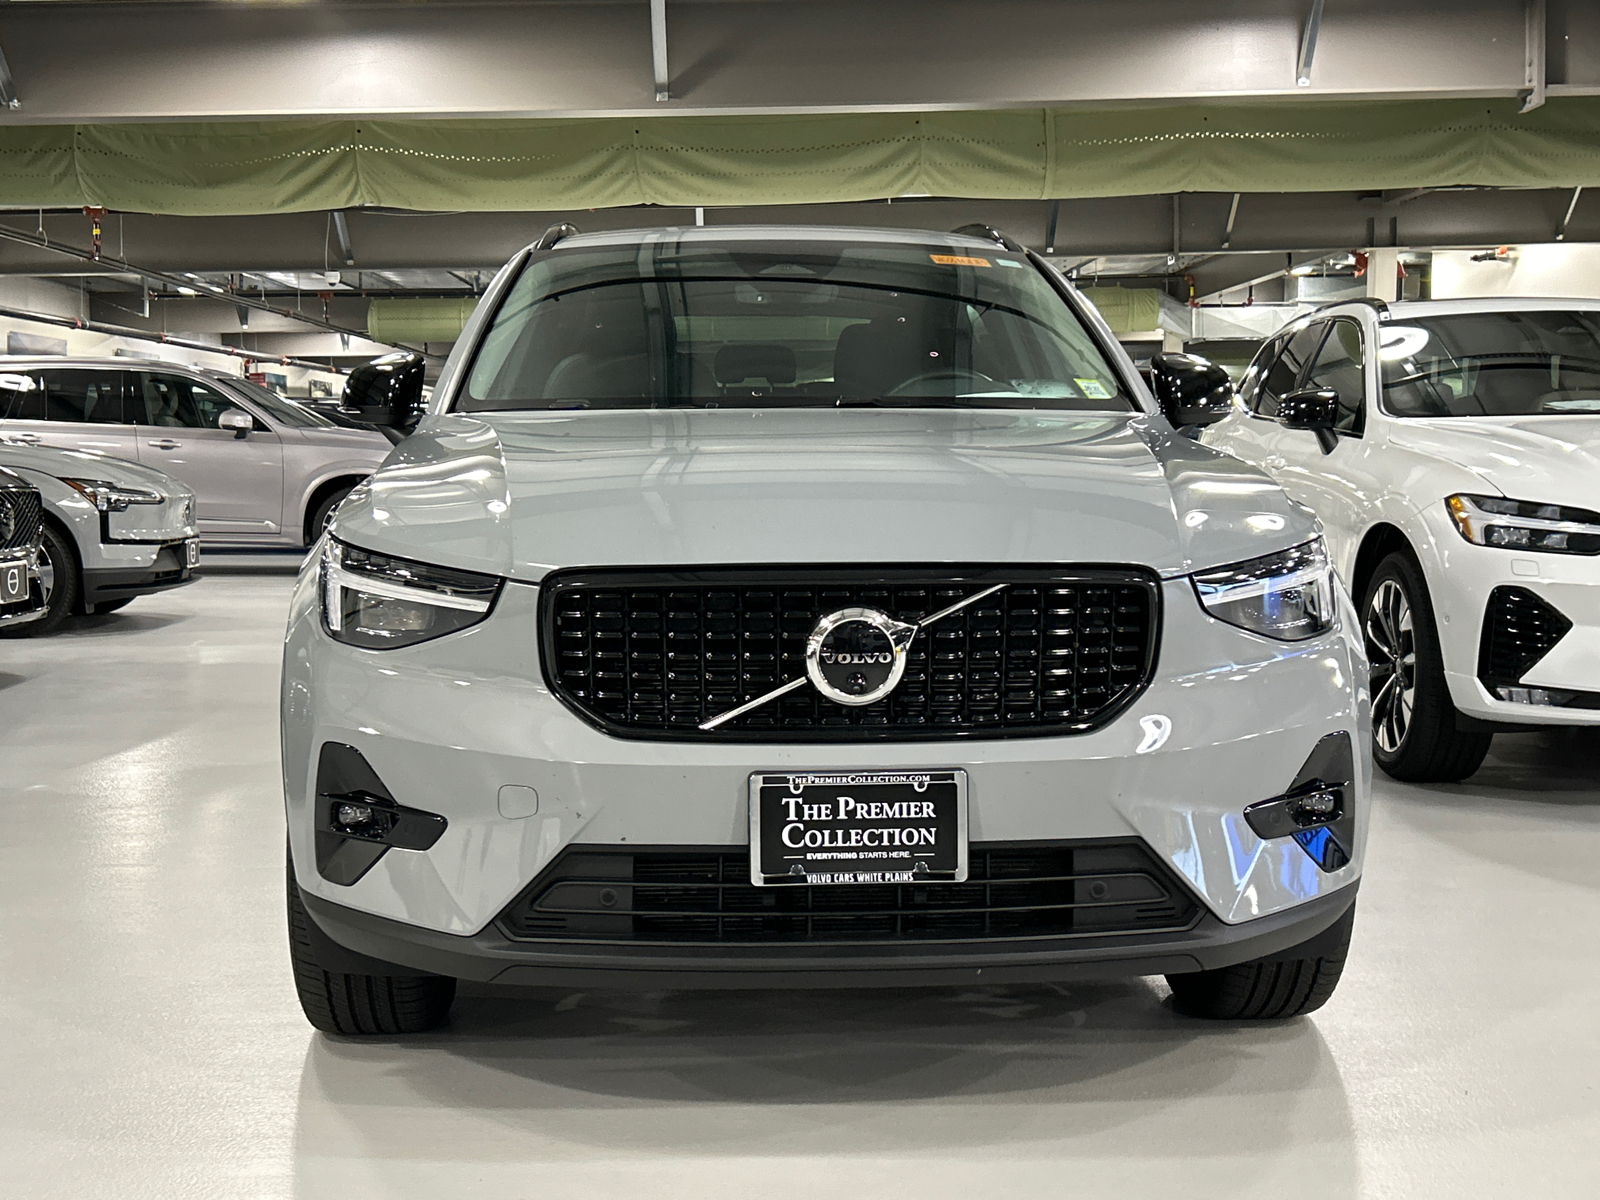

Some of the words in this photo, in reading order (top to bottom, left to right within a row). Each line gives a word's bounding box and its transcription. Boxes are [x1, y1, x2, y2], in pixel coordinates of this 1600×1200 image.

[821, 652, 892, 664] VOLVO
[781, 797, 833, 821] THE
[836, 796, 937, 820] PREMIER
[781, 822, 937, 848] COLLECTION
[806, 852, 858, 860] EVERYTHING
[858, 851, 888, 859] STARTS
[888, 851, 912, 859] HERE.
[806, 873, 832, 884] VOLVO
[833, 873, 855, 883] CARS
[856, 872, 883, 882] WHITE
[884, 871, 914, 882] PLAINS
